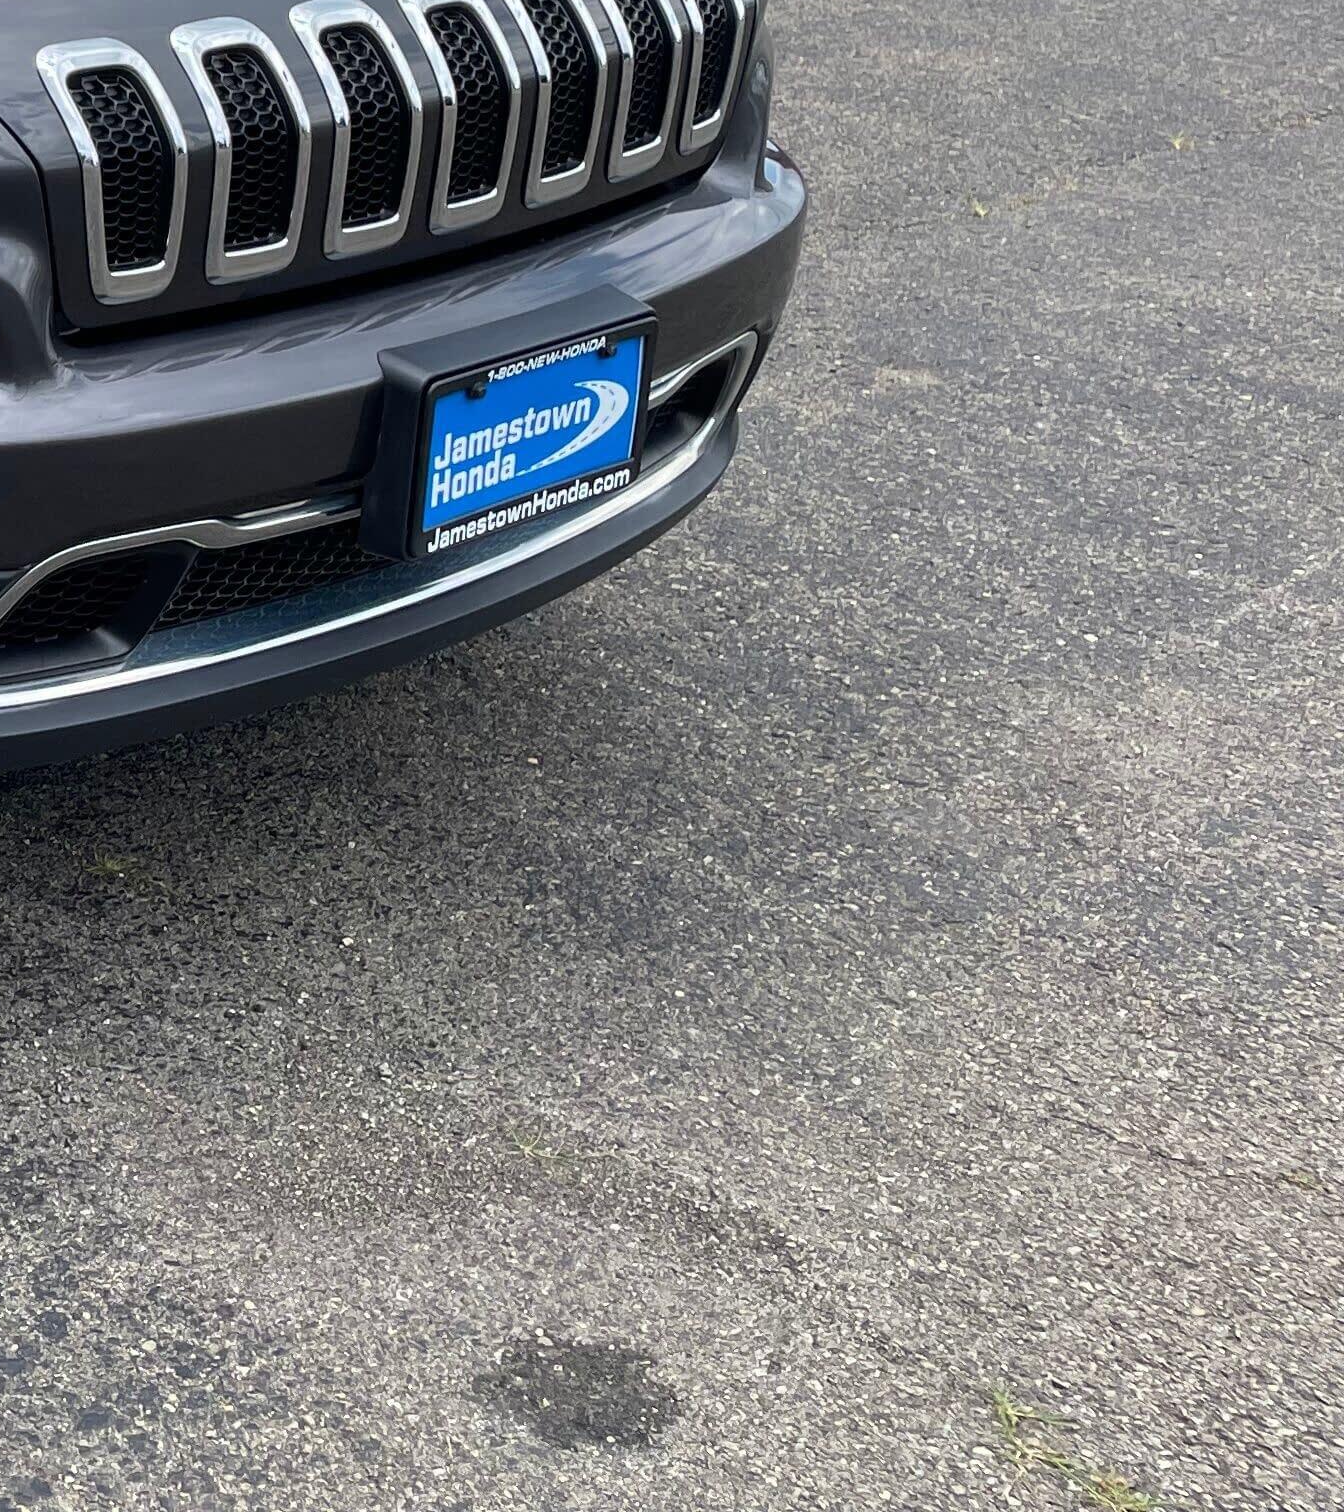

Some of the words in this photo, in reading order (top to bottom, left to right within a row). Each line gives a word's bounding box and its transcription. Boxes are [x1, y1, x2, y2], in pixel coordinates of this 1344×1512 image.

[487, 336, 607, 383] 1-800-NEW-HONDA
[433, 396, 592, 471] Jamestown
[427, 467, 631, 553] JamestownHonda.com
[430, 449, 516, 509] Honda
